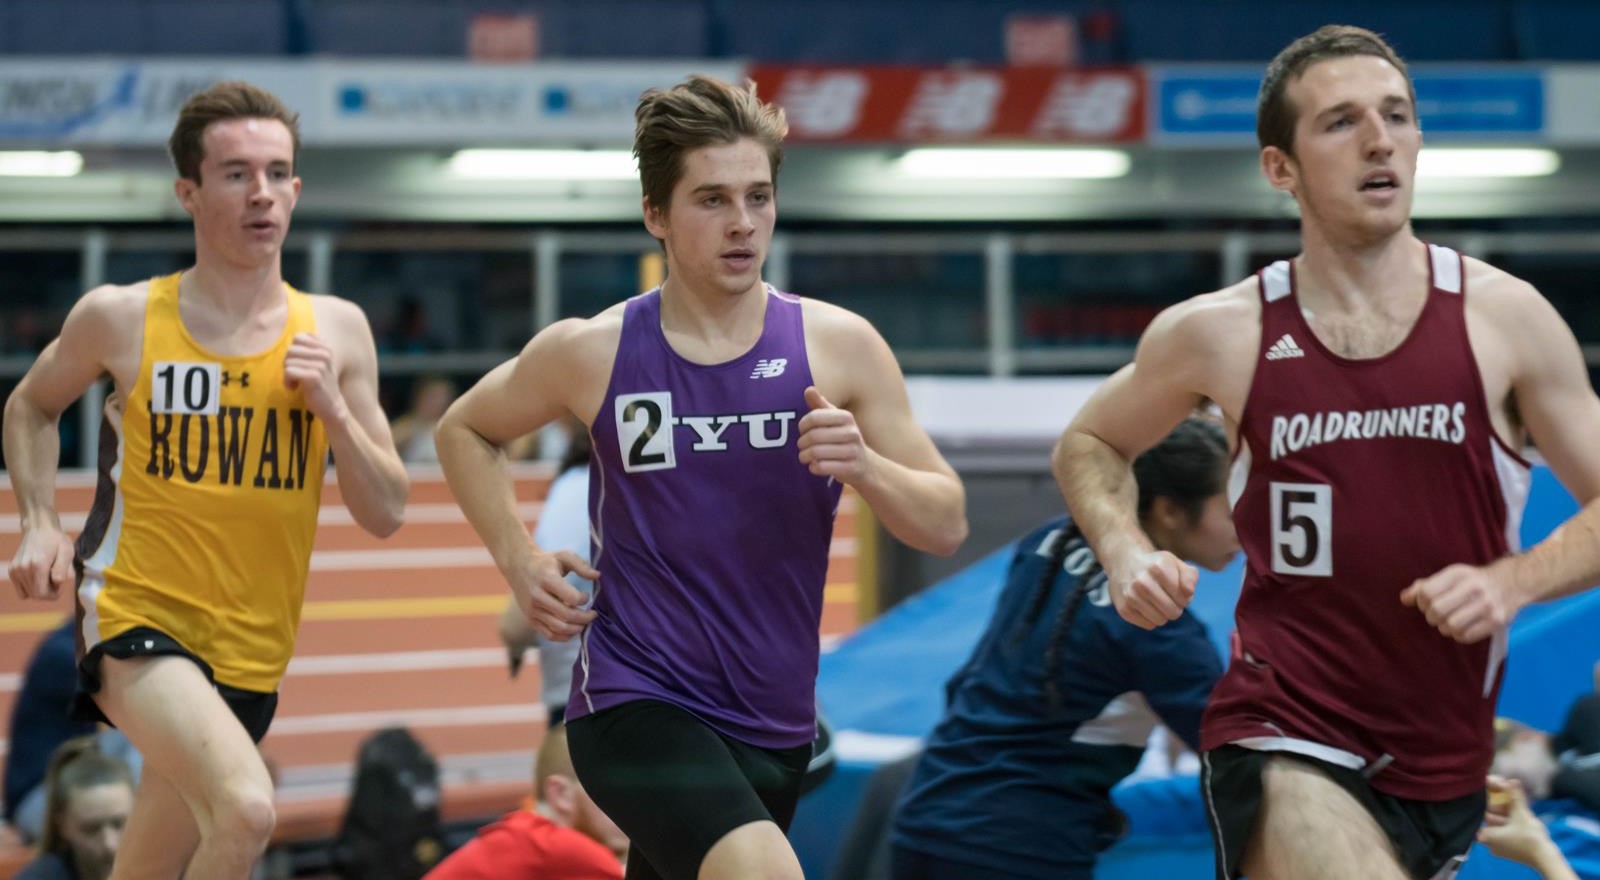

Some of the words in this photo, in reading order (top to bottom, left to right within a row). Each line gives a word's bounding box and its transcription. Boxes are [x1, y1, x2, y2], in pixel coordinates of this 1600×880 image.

[157, 364, 210, 411] 10
[750, 358, 788, 379] NB
[146, 400, 314, 489] ROWAN
[622, 399, 667, 466] 2
[672, 410, 797, 451] YU
[1270, 401, 1466, 461] ROADRUNNERS
[1279, 489, 1319, 568] 5
